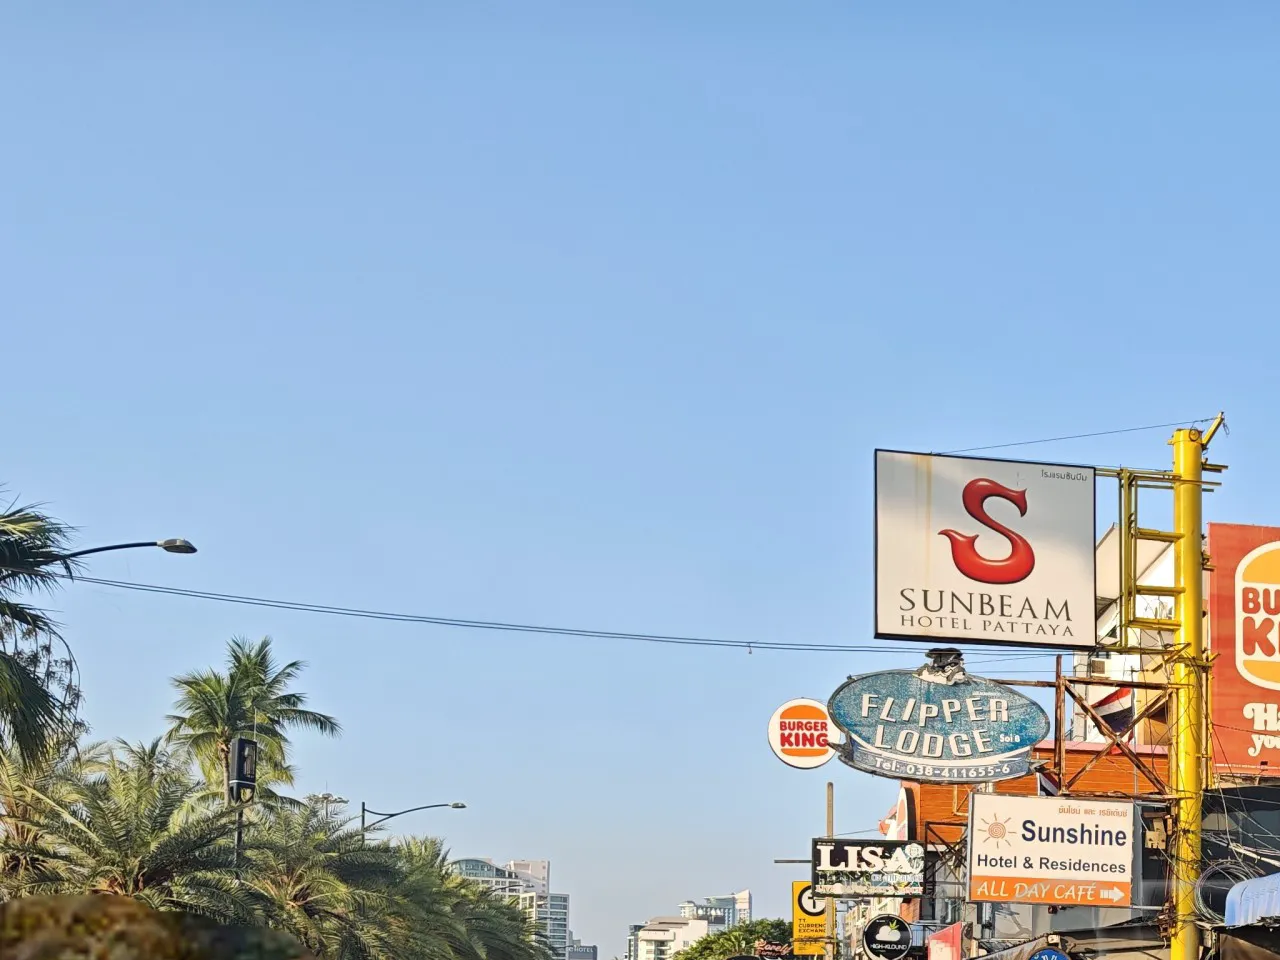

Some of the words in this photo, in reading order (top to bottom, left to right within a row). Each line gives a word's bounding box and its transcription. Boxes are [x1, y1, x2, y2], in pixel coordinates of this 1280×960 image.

[900, 588, 1072, 621] SUNBEAM
[901, 615, 972, 631] HOTEL
[983, 620, 1074, 637] PATTAYA
[861, 693, 1009, 727] FLIPPER
[780, 721, 828, 732] BURGER
[780, 732, 828, 748] KING
[875, 725, 994, 758] LODGE
[874, 758, 901, 772] Tel:
[906, 764, 1011, 779] 038-411655-6
[1022, 819, 1127, 846] Sunshine
[816, 845, 913, 874] LISA
[977, 854, 1017, 868] Hotel
[1023, 857, 1034, 869] &
[1040, 857, 1126, 873] Residences
[976, 880, 1009, 897] ALL
[1014, 883, 1050, 899] DAY
[1054, 882, 1097, 901] CAFÉ
